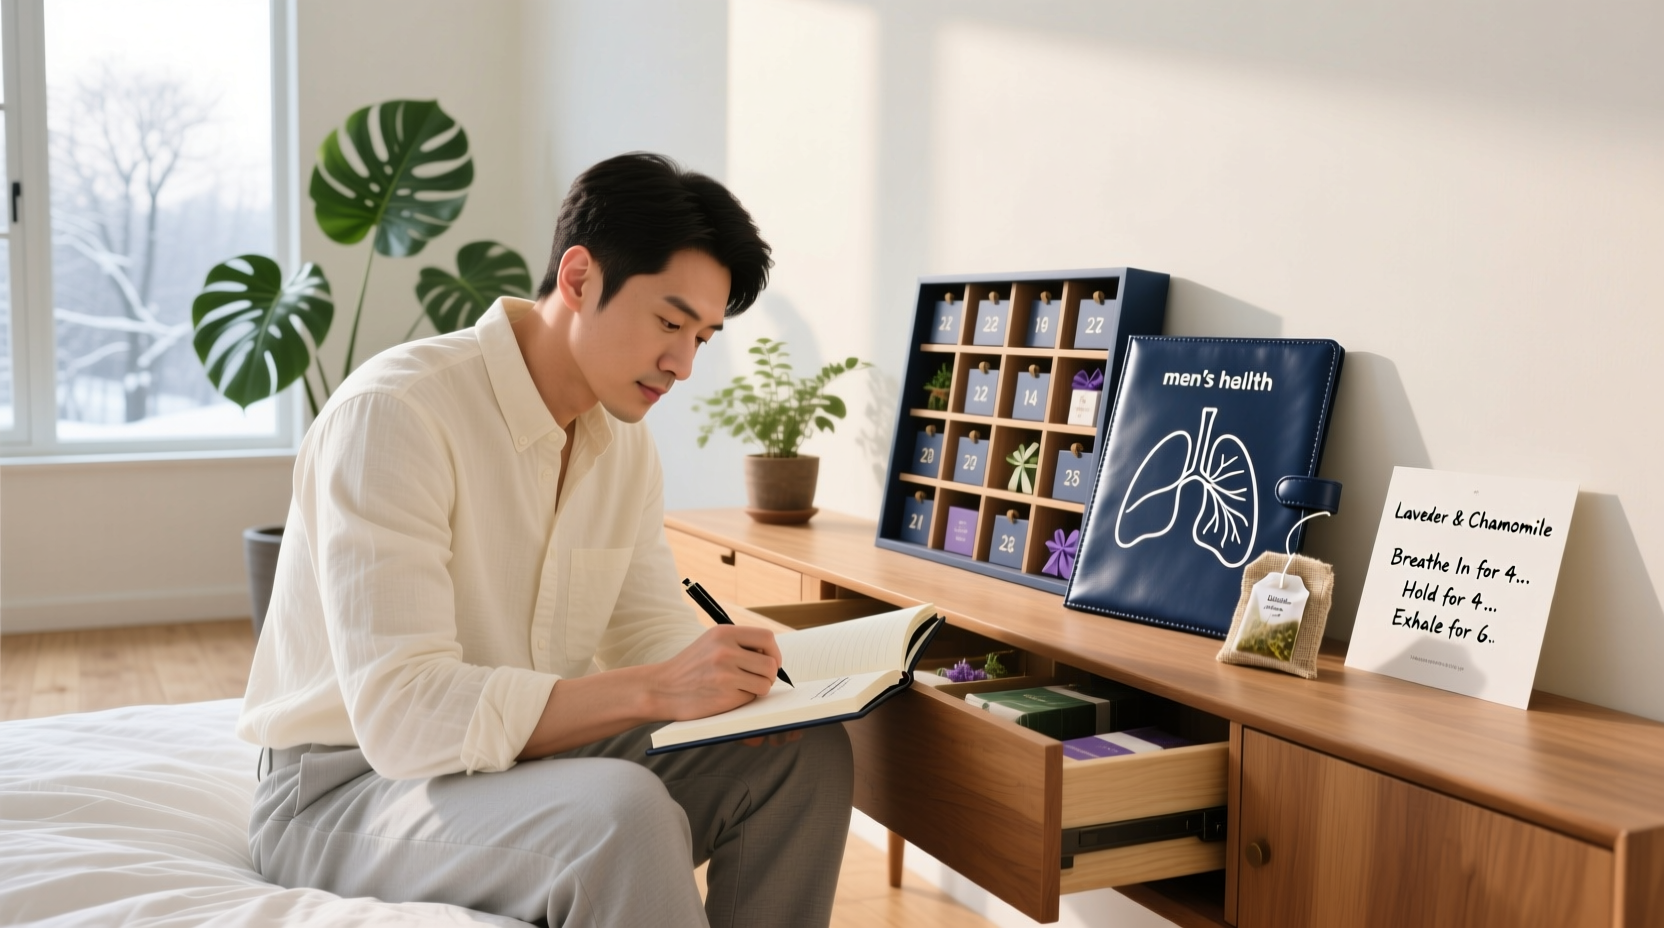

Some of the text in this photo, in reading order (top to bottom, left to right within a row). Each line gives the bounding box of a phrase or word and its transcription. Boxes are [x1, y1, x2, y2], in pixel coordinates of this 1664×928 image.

[1163, 369, 1214, 388] men's
[974, 386, 988, 402] 22
[1024, 390, 1038, 406] 14
[1395, 501, 1553, 537] Laveder & Chamomile
[1391, 548, 1450, 572] Breathe
[1455, 557, 1470, 574] In
[1476, 560, 1500, 580] for
[1402, 580, 1439, 602] Hold
[1442, 587, 1465, 606] for
[1392, 608, 1443, 634] Exhale
[1448, 619, 1472, 639] for
